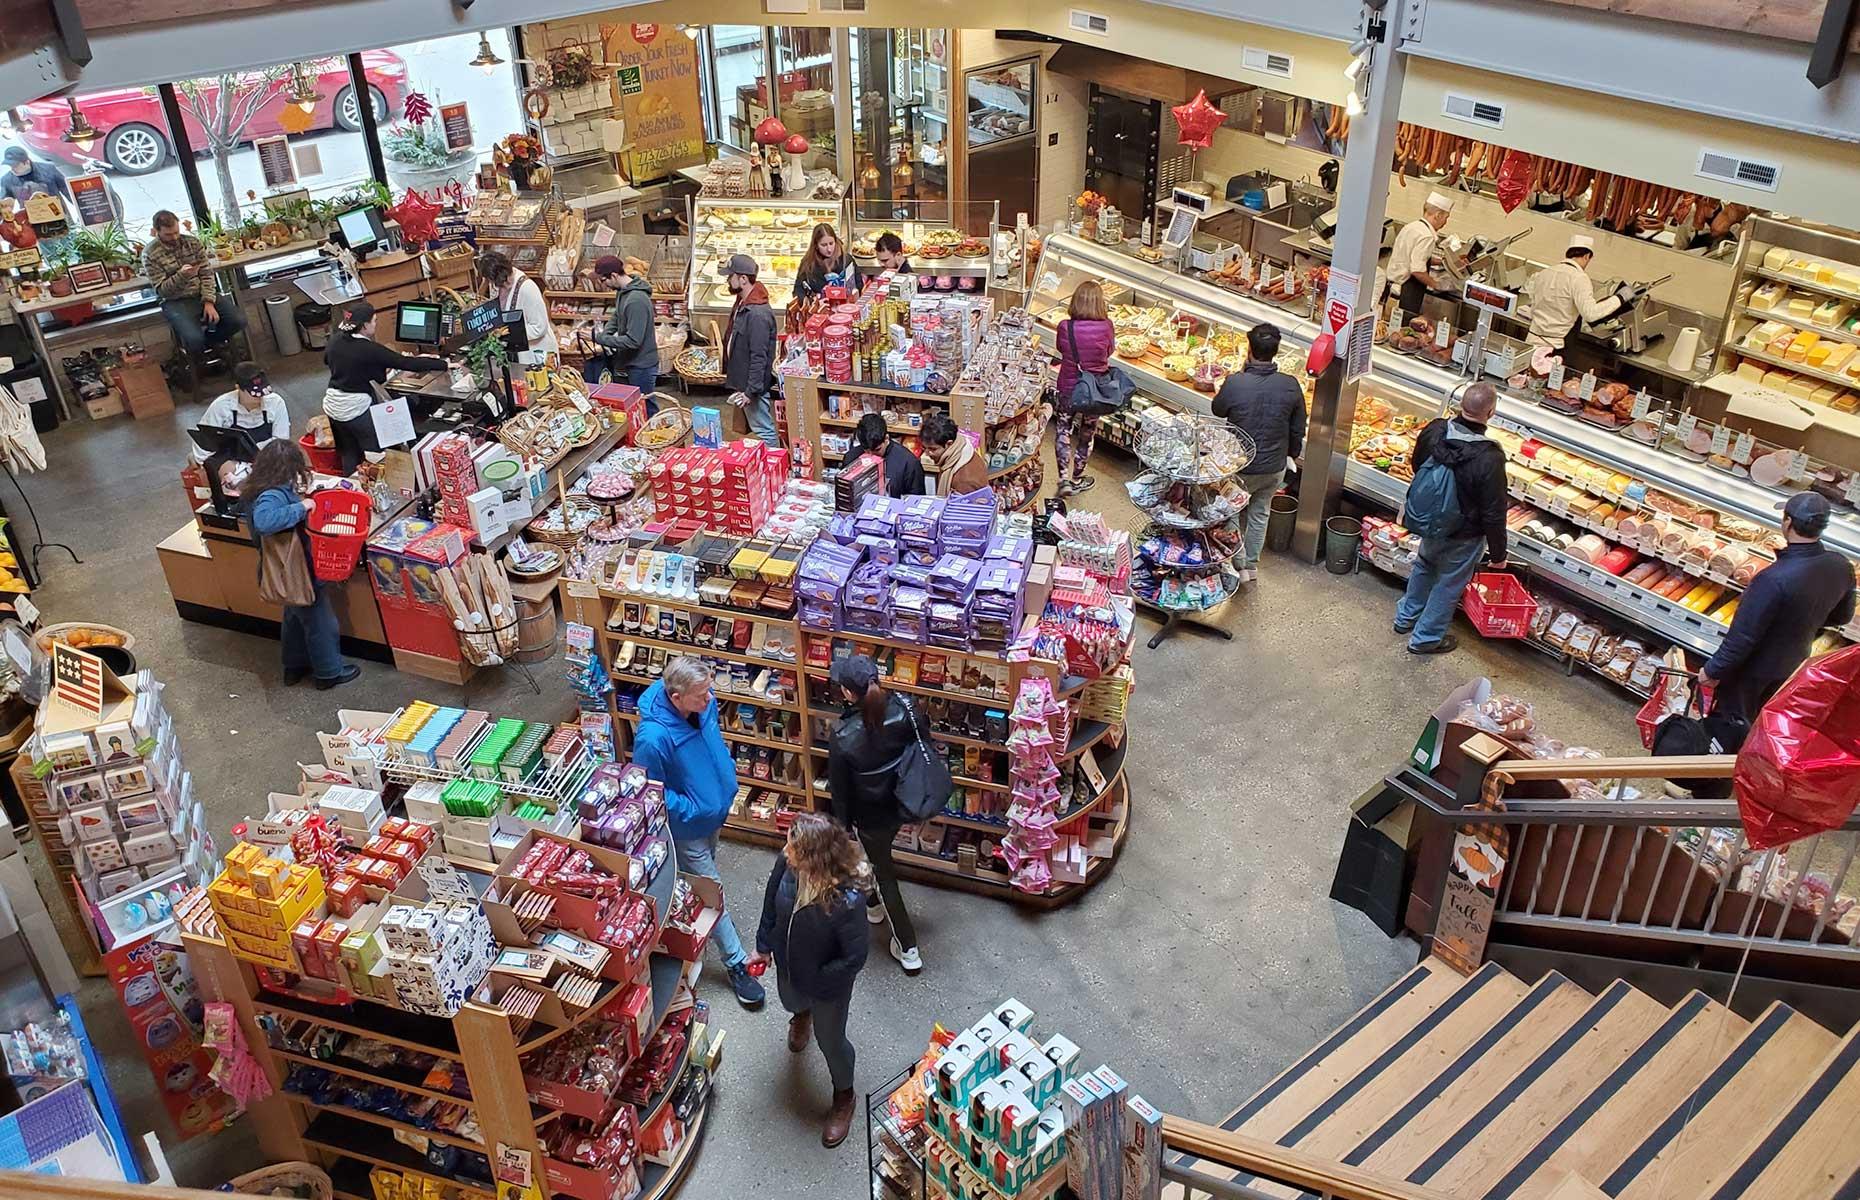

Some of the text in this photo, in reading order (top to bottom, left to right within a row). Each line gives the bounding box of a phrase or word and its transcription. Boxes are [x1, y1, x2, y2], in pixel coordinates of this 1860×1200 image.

[616, 39, 688, 65] ORDER YOUR FRESH
[641, 59, 692, 83] TURKEY NOW
[902, 521, 924, 530] Milka
[806, 561, 823, 570] Milka
[328, 740, 350, 749] buen
[257, 826, 286, 836] bueno
[1450, 894, 1478, 921] Fall
